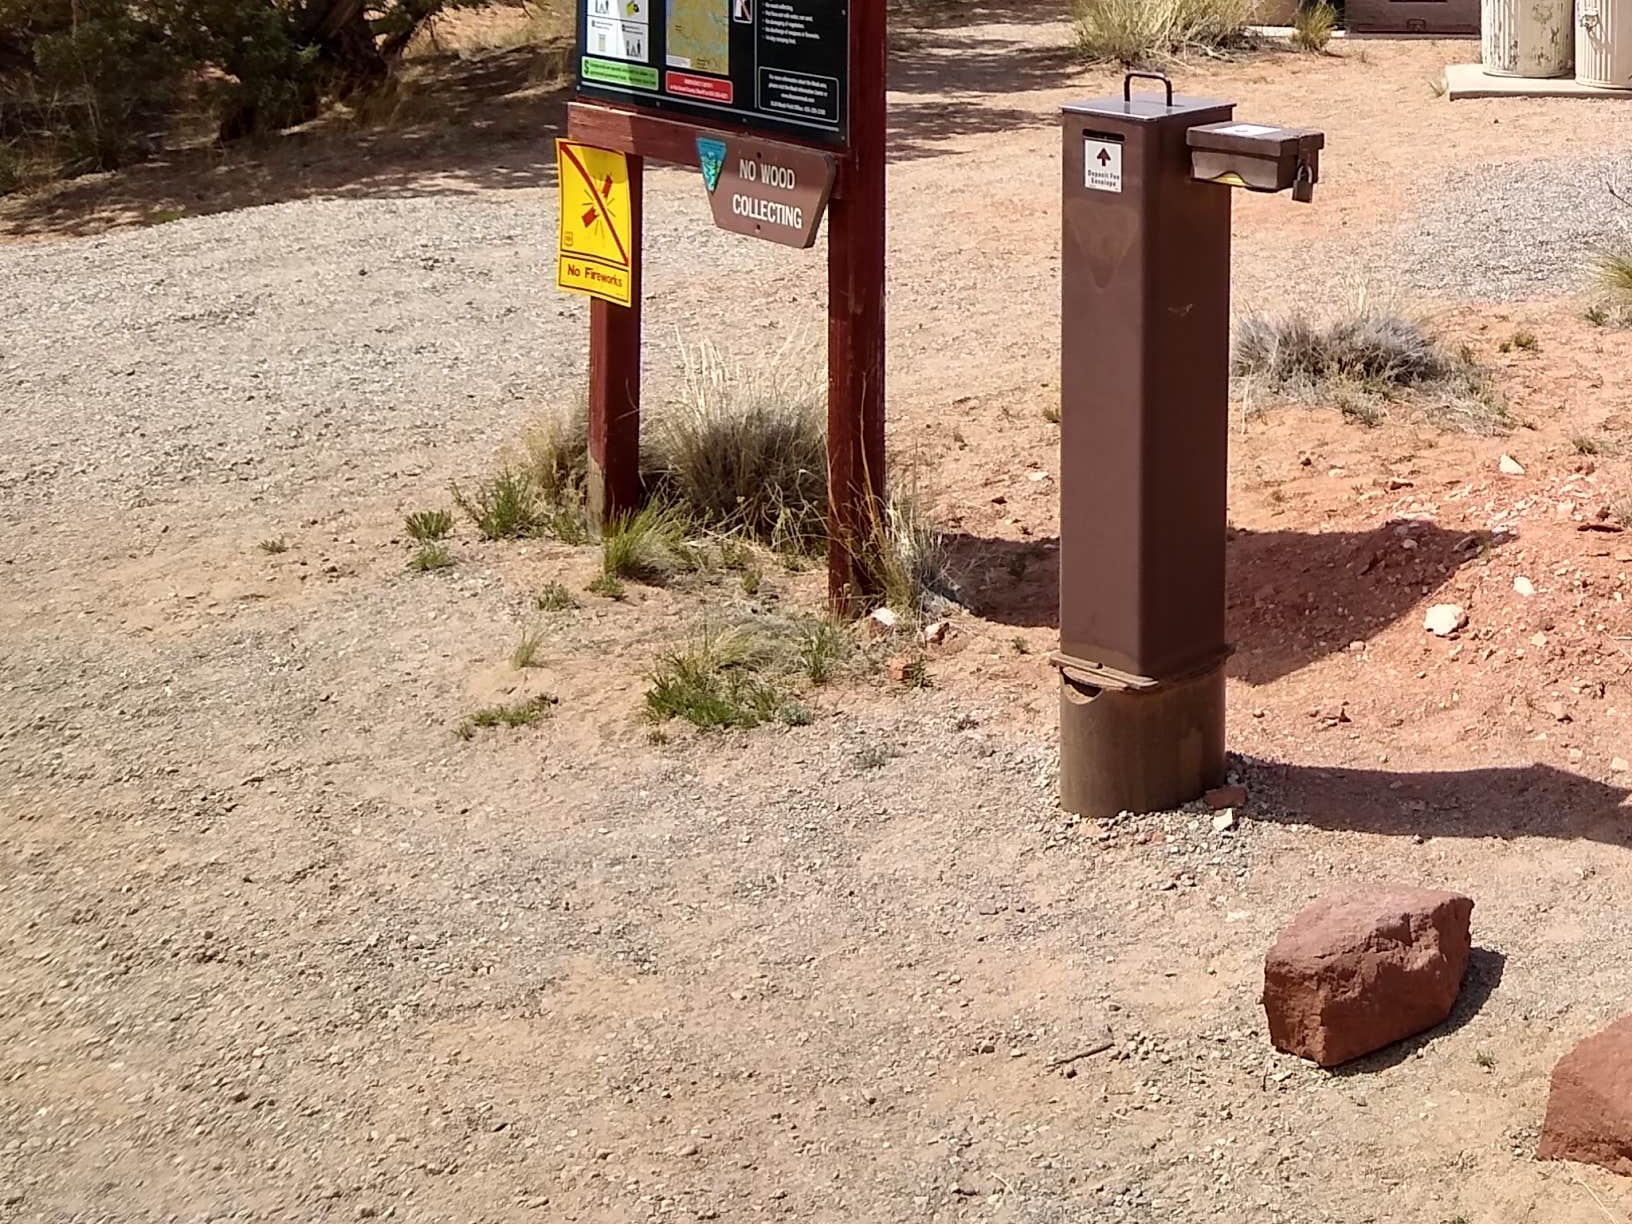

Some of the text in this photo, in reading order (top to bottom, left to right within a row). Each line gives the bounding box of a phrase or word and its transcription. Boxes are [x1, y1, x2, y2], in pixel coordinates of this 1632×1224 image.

[739, 159, 795, 190] NO WOOD
[732, 194, 803, 229] COLLECTING
[567, 264, 623, 288] No Fireworks
